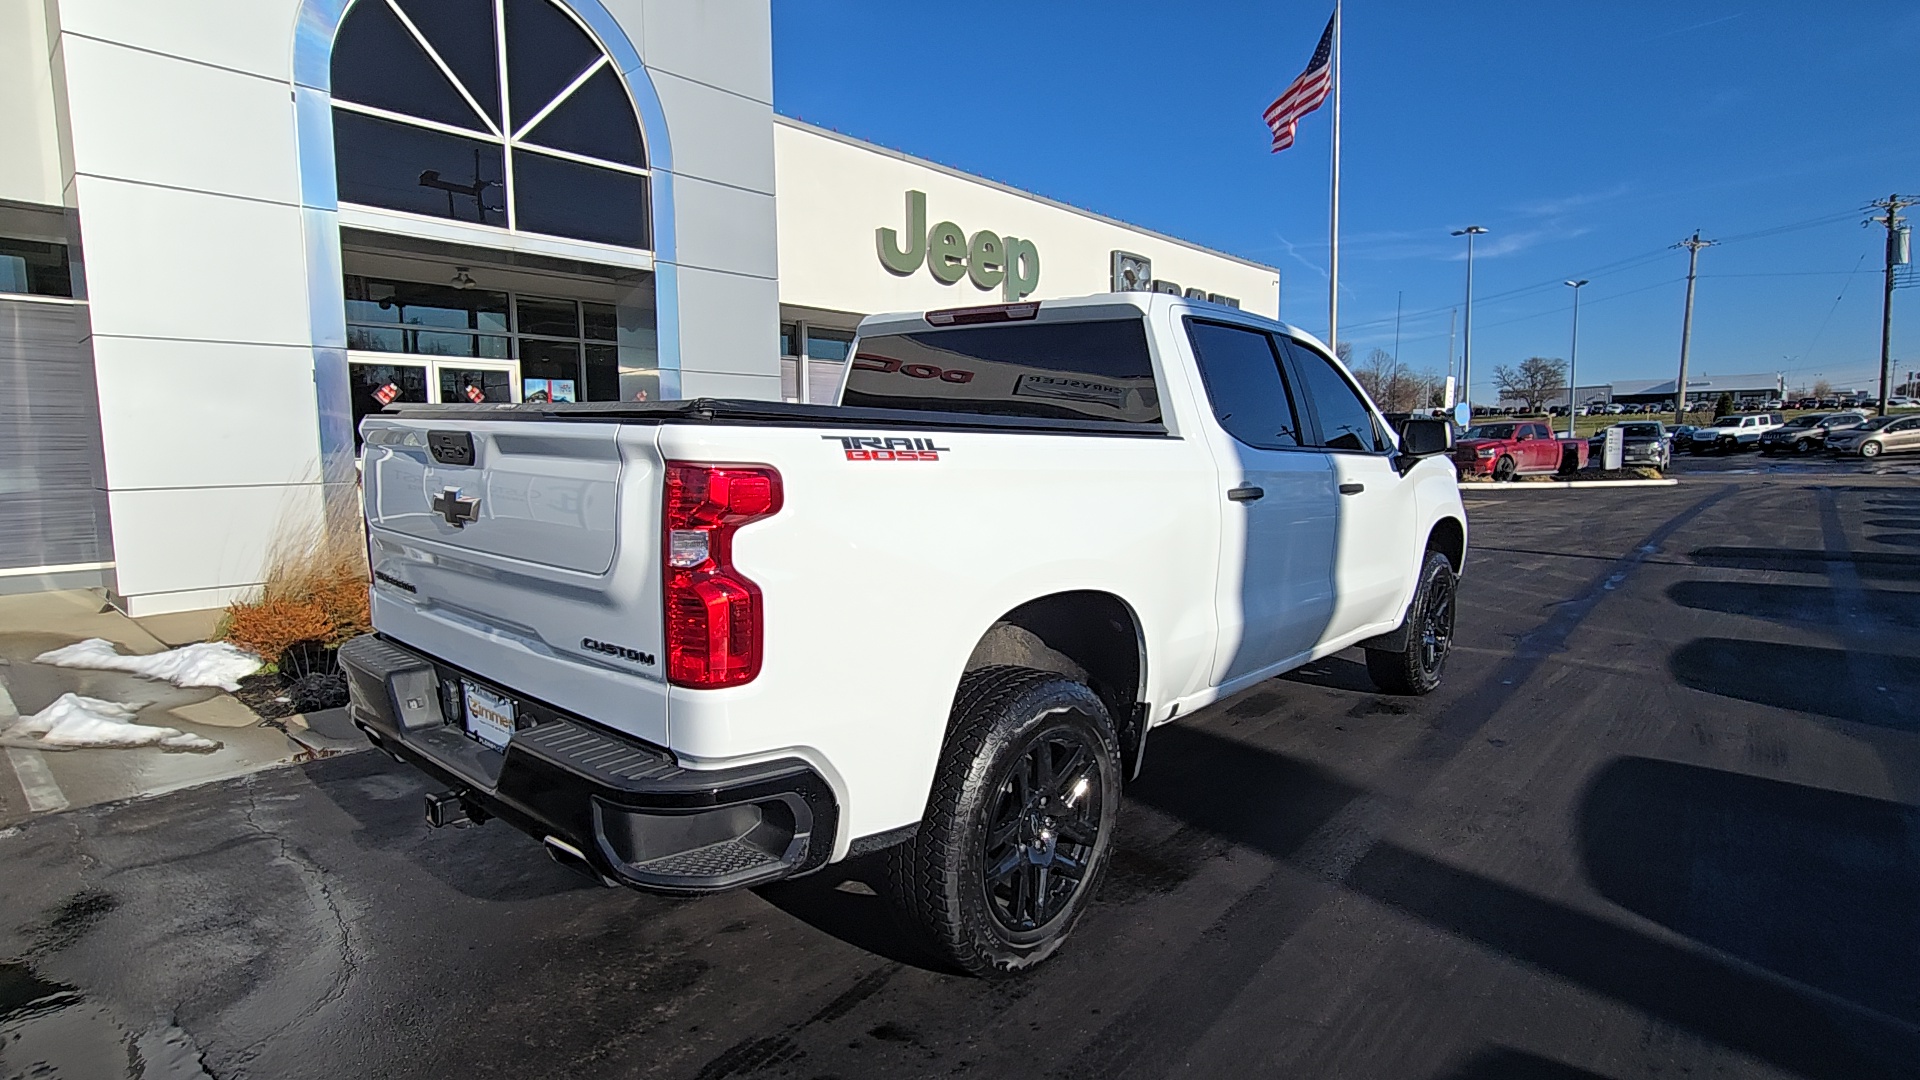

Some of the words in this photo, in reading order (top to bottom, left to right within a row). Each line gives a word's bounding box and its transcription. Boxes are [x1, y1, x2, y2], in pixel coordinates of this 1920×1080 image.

[875, 190, 1040, 302] Jeep
[821, 435, 951, 452] TRAIL
[844, 449, 940, 462] BOSS
[581, 637, 656, 666] CUSTOM
